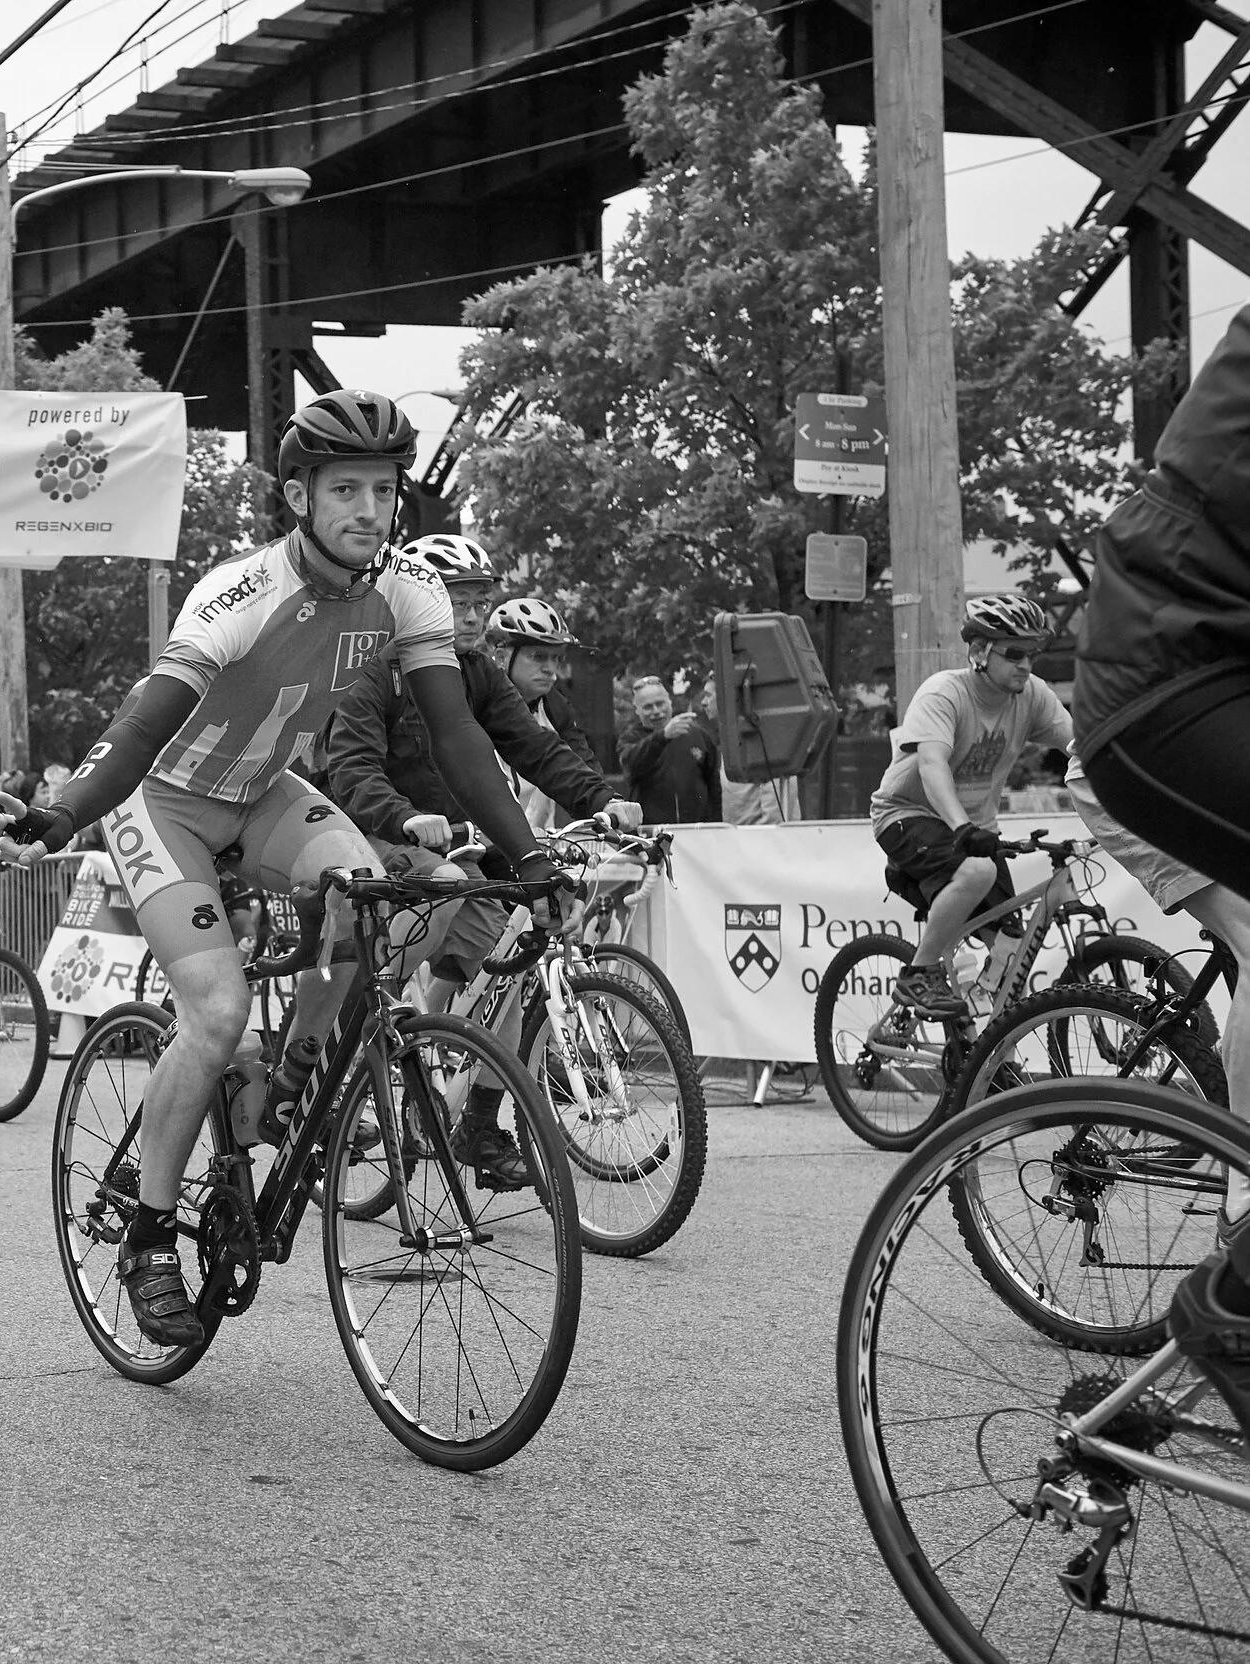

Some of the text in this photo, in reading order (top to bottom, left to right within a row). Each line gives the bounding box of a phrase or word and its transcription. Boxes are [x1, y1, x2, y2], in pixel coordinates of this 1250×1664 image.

[28, 406, 130, 427] powered by
[841, 438, 849, 450] 8
[851, 440, 870, 452] pm
[15, 521, 112, 532] REGENXBIO
[198, 574, 257, 624] impact
[104, 806, 165, 888] HOK
[67, 898, 101, 914] BIKE
[61, 911, 95, 927] RIDE
[276, 915, 301, 931] RID
[798, 903, 904, 949] Penn
[274, 1013, 343, 1182] SCOTT
